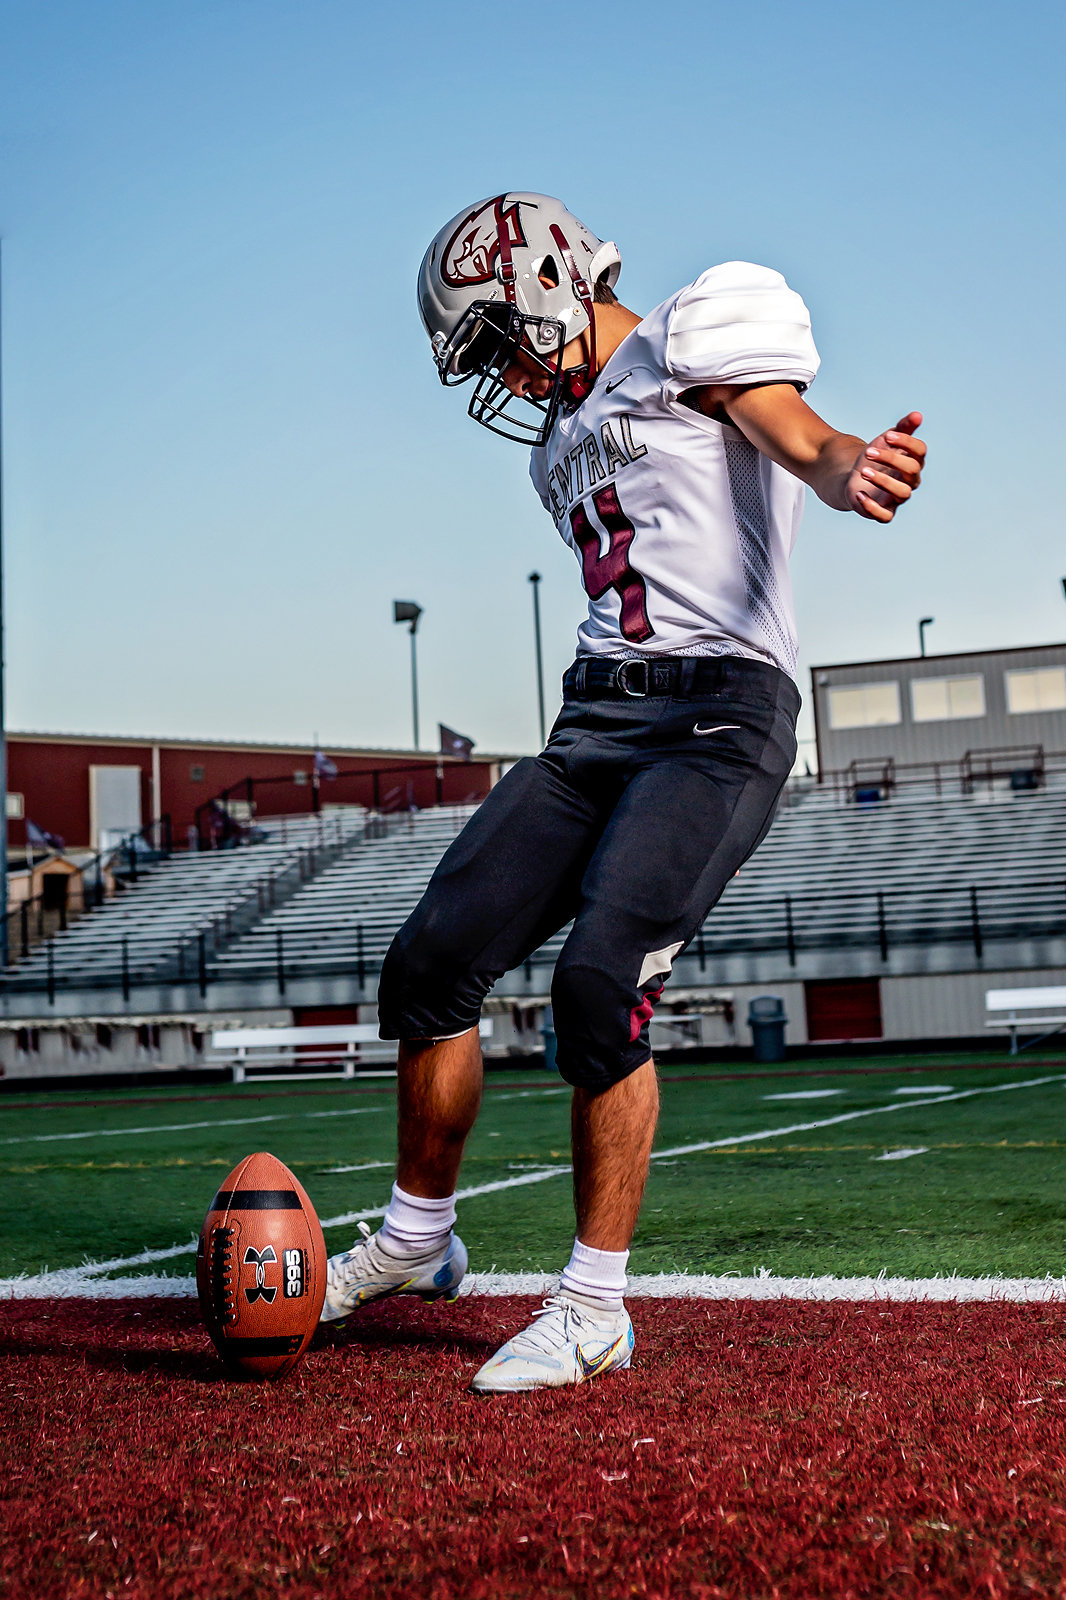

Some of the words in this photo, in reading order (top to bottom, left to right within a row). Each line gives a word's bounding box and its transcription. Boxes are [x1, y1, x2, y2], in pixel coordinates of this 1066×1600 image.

[580, 239, 594, 255] 4
[568, 480, 656, 644] 4
[286, 1249, 301, 1297] 395
